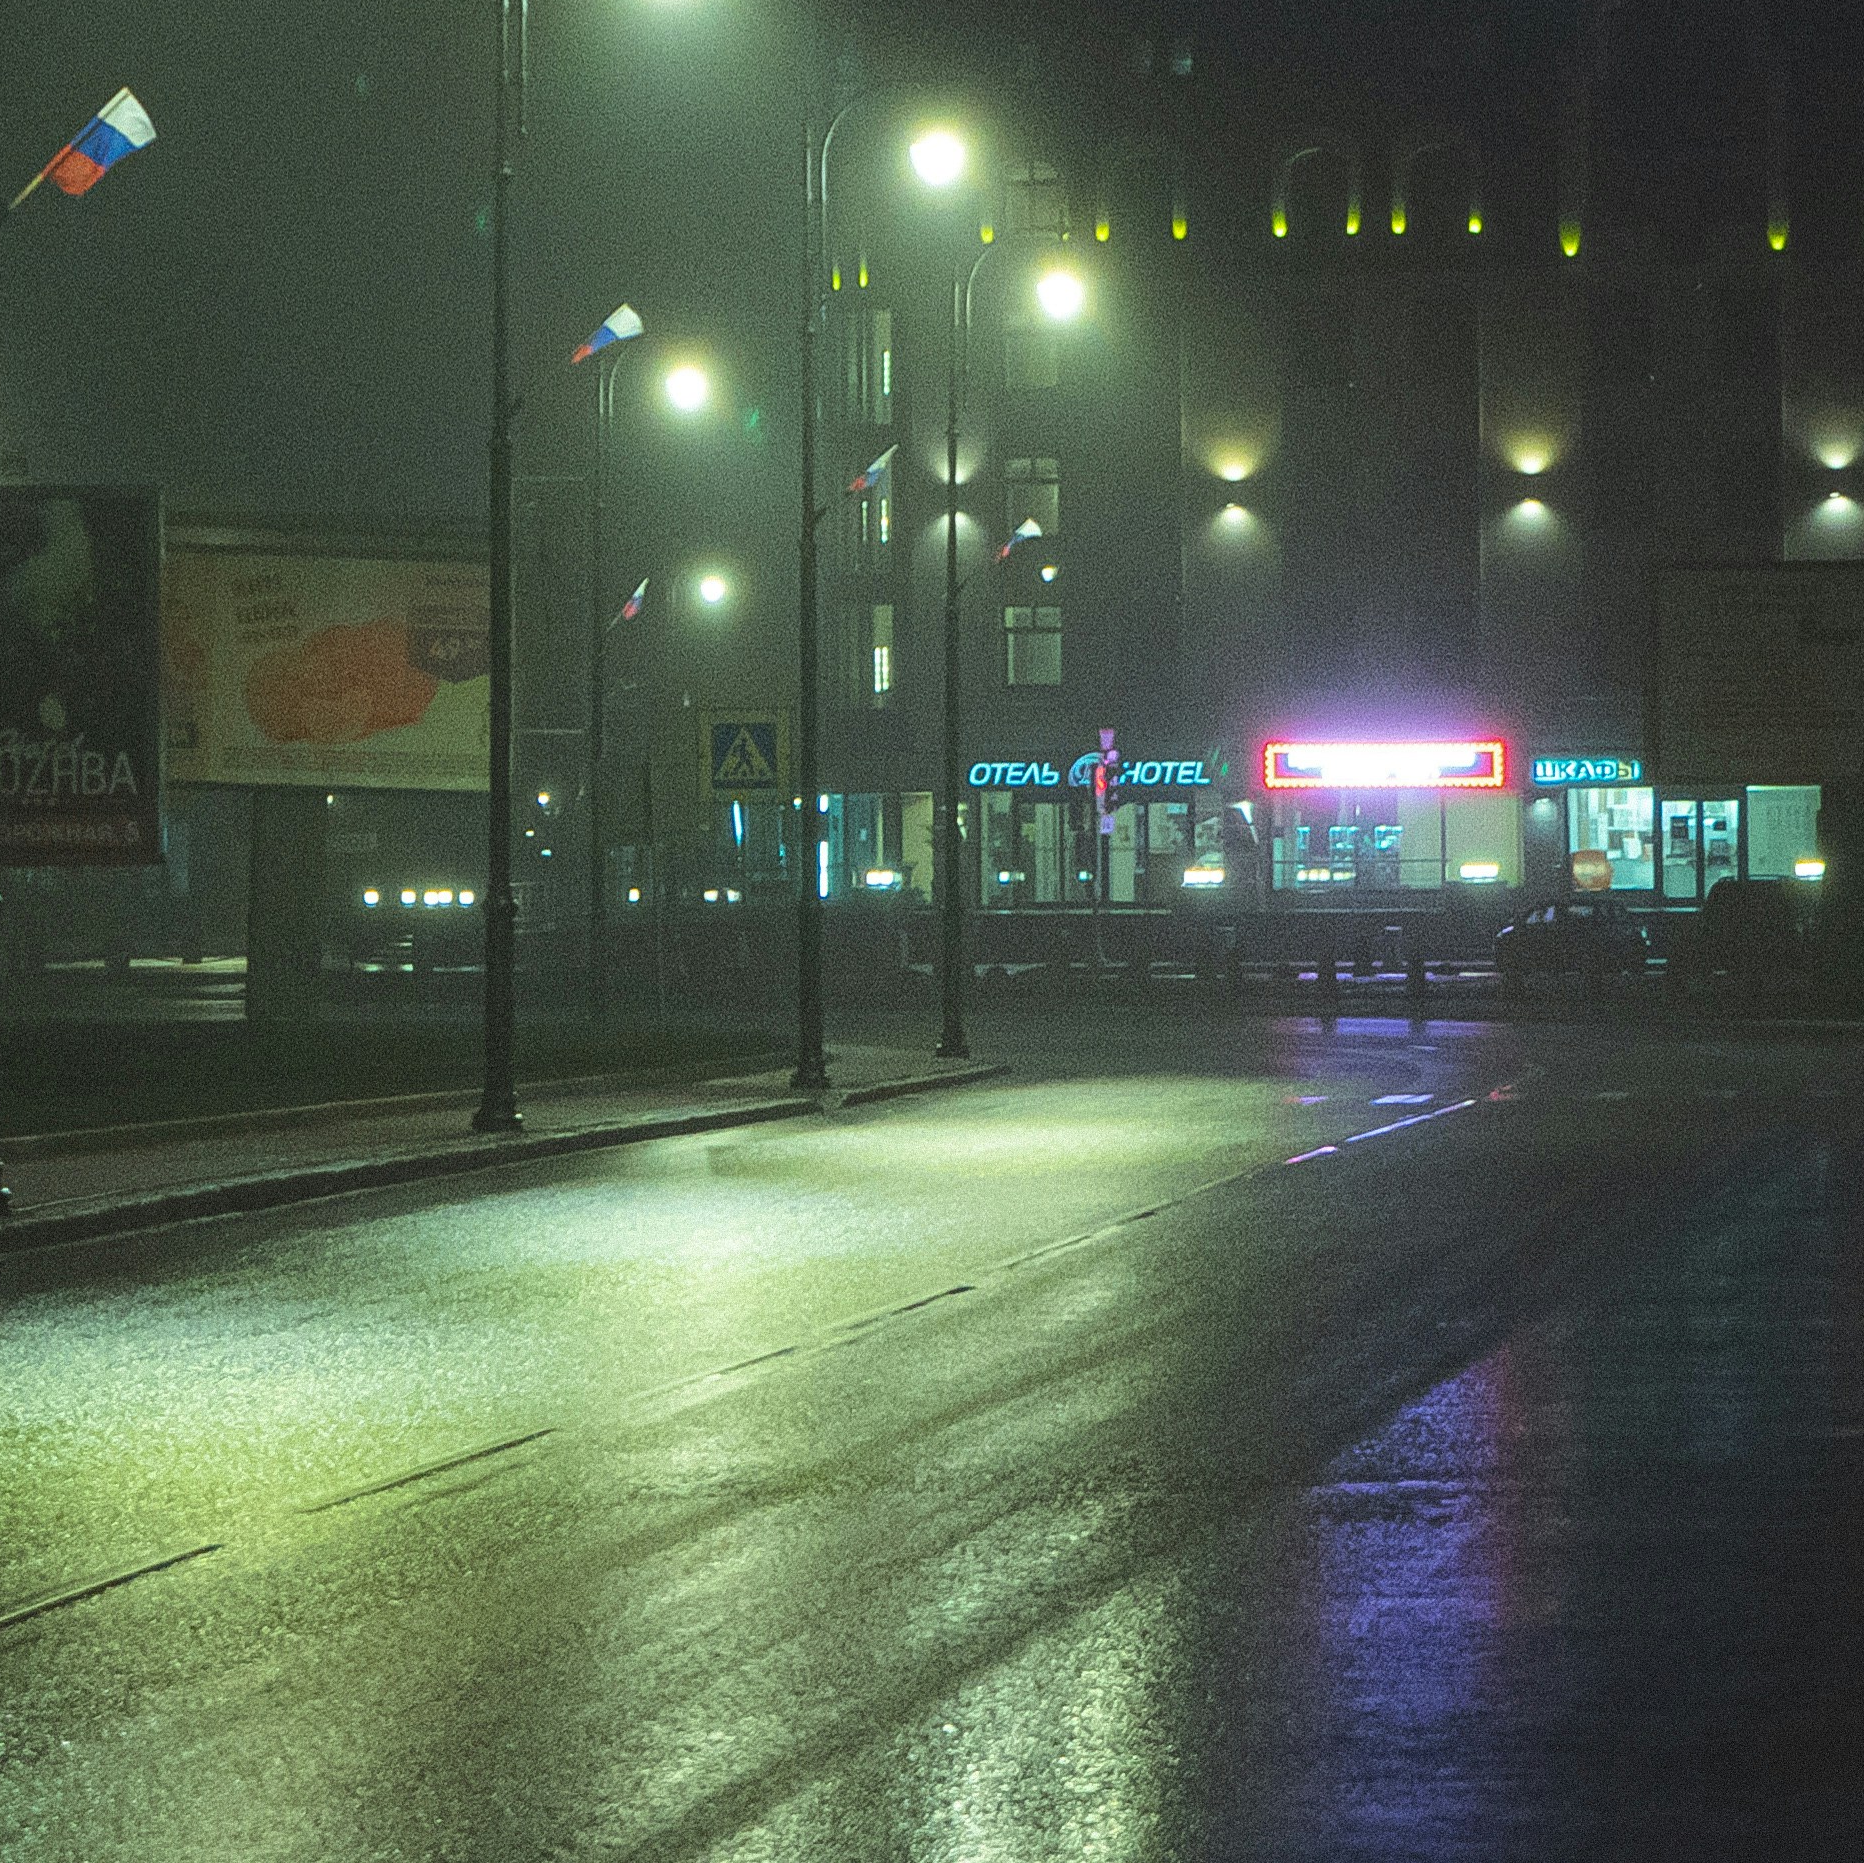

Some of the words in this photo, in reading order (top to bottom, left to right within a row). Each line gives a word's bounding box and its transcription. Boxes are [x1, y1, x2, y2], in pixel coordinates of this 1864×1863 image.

[969, 762, 1059, 785] ОТЕЛЬ
[1120, 761, 1210, 784] HOTEL
[1534, 760, 1640, 783] ШКАФЫ
